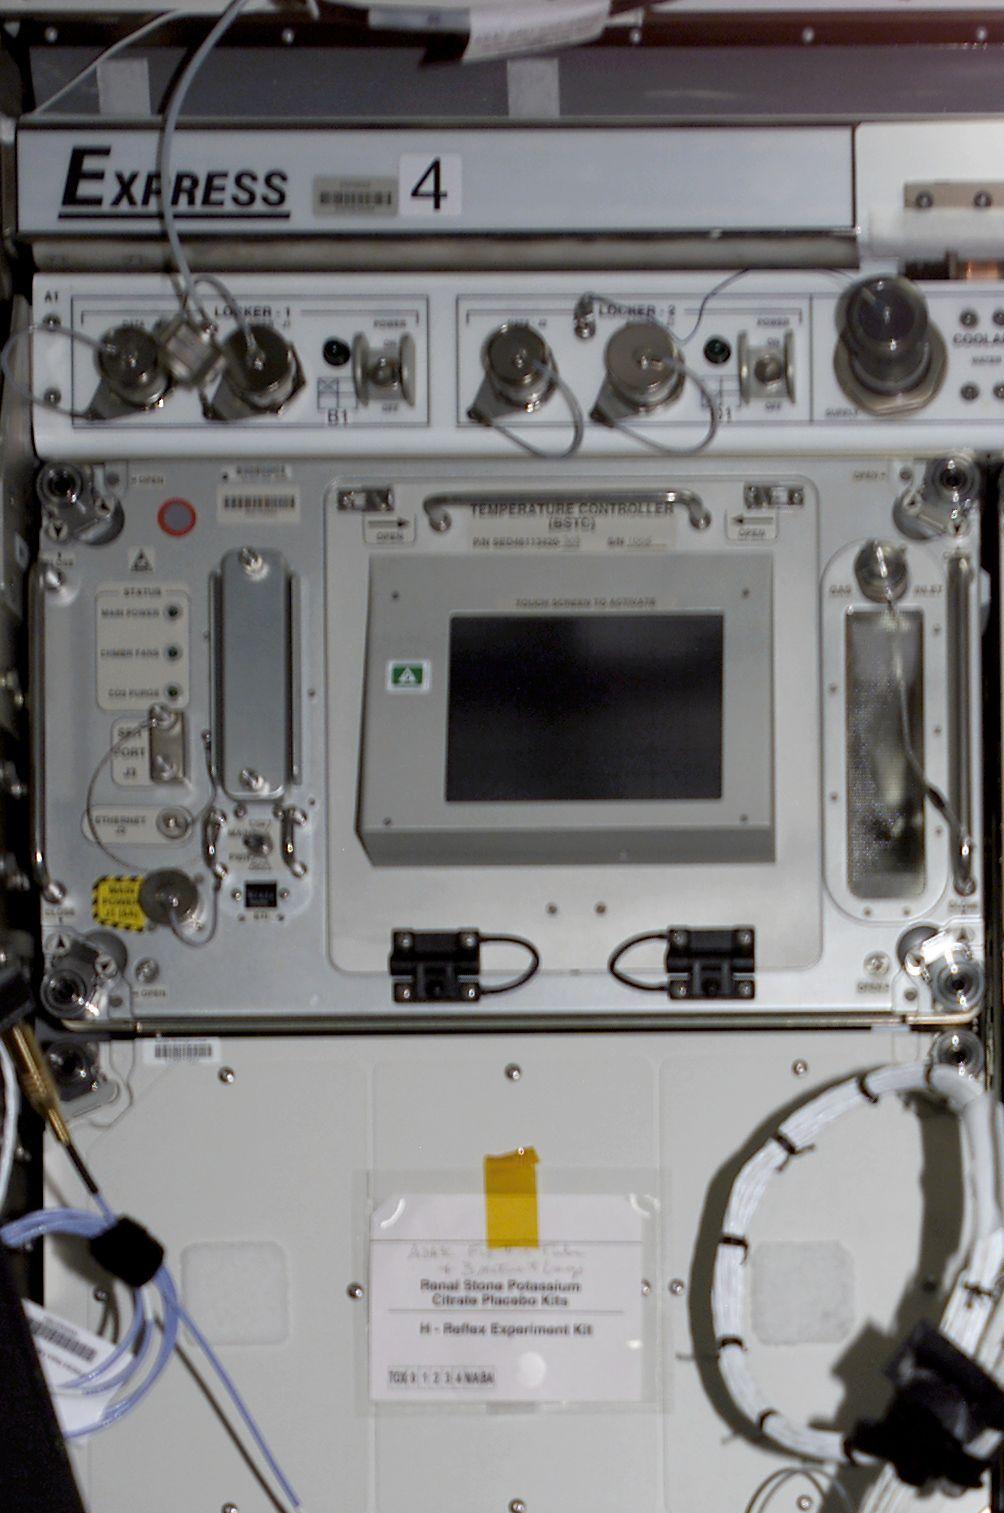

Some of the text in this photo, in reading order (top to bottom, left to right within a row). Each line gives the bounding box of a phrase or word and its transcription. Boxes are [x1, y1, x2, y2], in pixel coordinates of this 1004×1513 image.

[61, 146, 289, 207] EXPRESS
[410, 158, 449, 211] 4
[598, 304, 656, 316] LOCKER
[327, 410, 350, 426] B1
[470, 502, 674, 516] TEMPERATURE CONTROLLER
[122, 586, 162, 597] STATUS
[594, 597, 607, 609] TO
[126, 607, 160, 618] POWER
[420, 1279, 581, 1293] Renal Stone Potassium
[432, 1294, 569, 1307] Citrate Placebo Kits
[420, 1322, 593, 1338] H Reflex Experiment Kit
